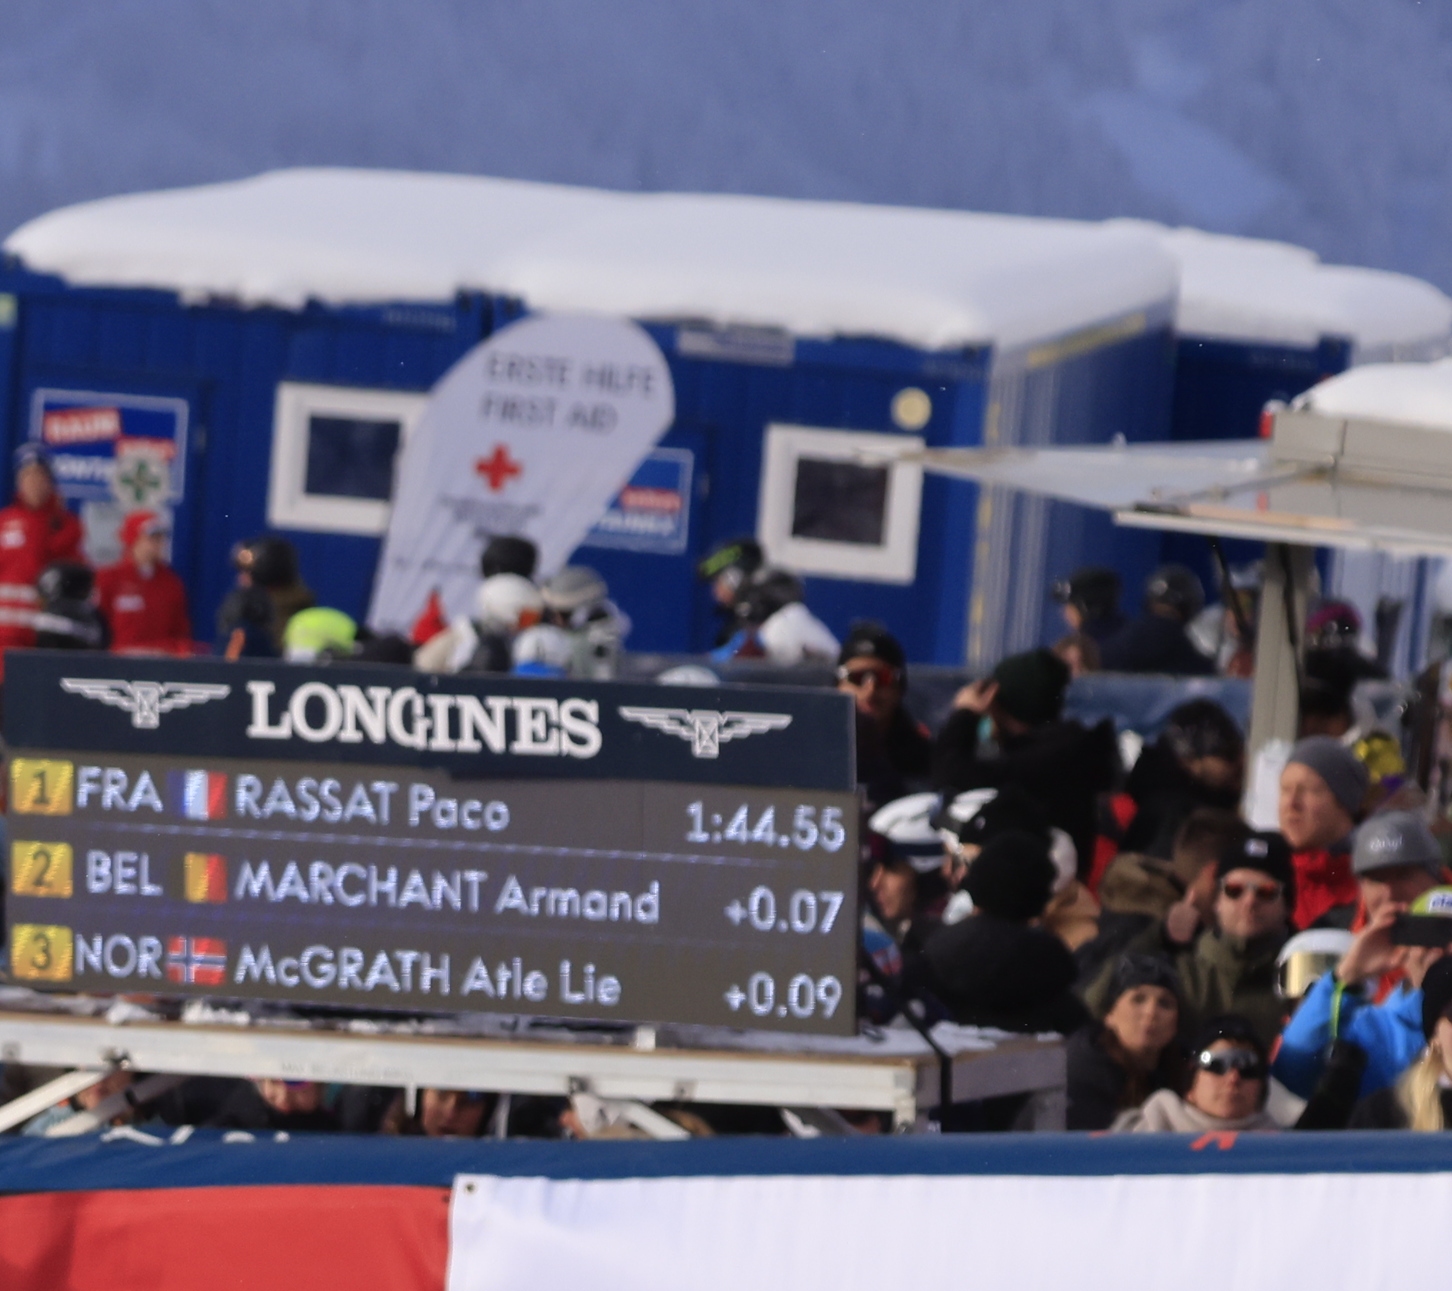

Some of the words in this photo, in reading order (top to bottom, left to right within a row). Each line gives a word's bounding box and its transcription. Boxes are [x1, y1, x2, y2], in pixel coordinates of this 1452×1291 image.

[245, 680, 602, 759] LONGINES
[76, 766, 161, 814] FRA
[235, 773, 398, 826] RASSAT
[408, 790, 509, 832] Paco
[686, 801, 845, 853] 1:44.55
[87, 850, 163, 897] BEL
[235, 859, 487, 912] MARCHANT
[497, 875, 660, 925] Armand
[726, 887, 844, 935] +0.07
[76, 933, 162, 979] NOR
[235, 945, 450, 997] McGRATH
[462, 955, 548, 1002] Atle
[560, 960, 621, 1004] Lie
[726, 973, 842, 1019] +0.09
